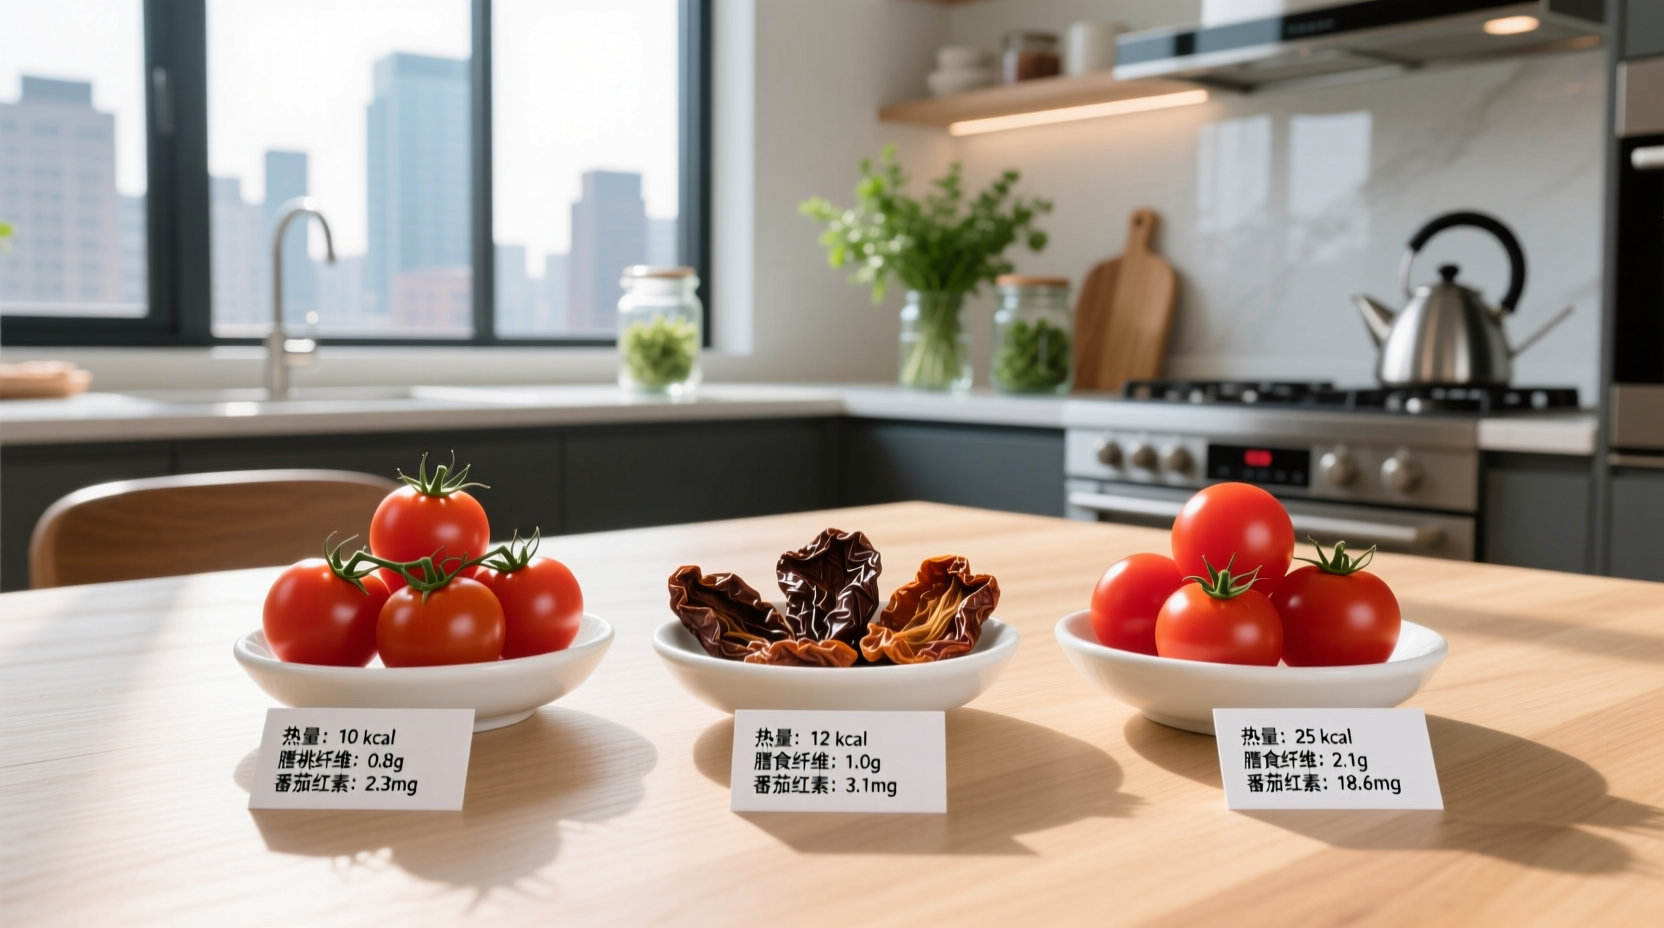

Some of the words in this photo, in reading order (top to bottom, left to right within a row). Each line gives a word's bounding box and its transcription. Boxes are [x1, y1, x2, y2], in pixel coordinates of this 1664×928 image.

[340, 729, 358, 744] 10
[363, 729, 396, 745] kcal
[812, 731, 829, 746] 12
[836, 731, 867, 746] kcal
[1295, 728, 1315, 744] 25
[1320, 728, 1352, 744] kcal
[368, 753, 404, 772] 0.8g
[846, 754, 880, 773] 1.0g
[1332, 752, 1368, 771] 2.1g
[365, 776, 418, 796] 2.3mg
[846, 777, 897, 797] 3.1mg
[1338, 775, 1401, 794] 18.6mg
